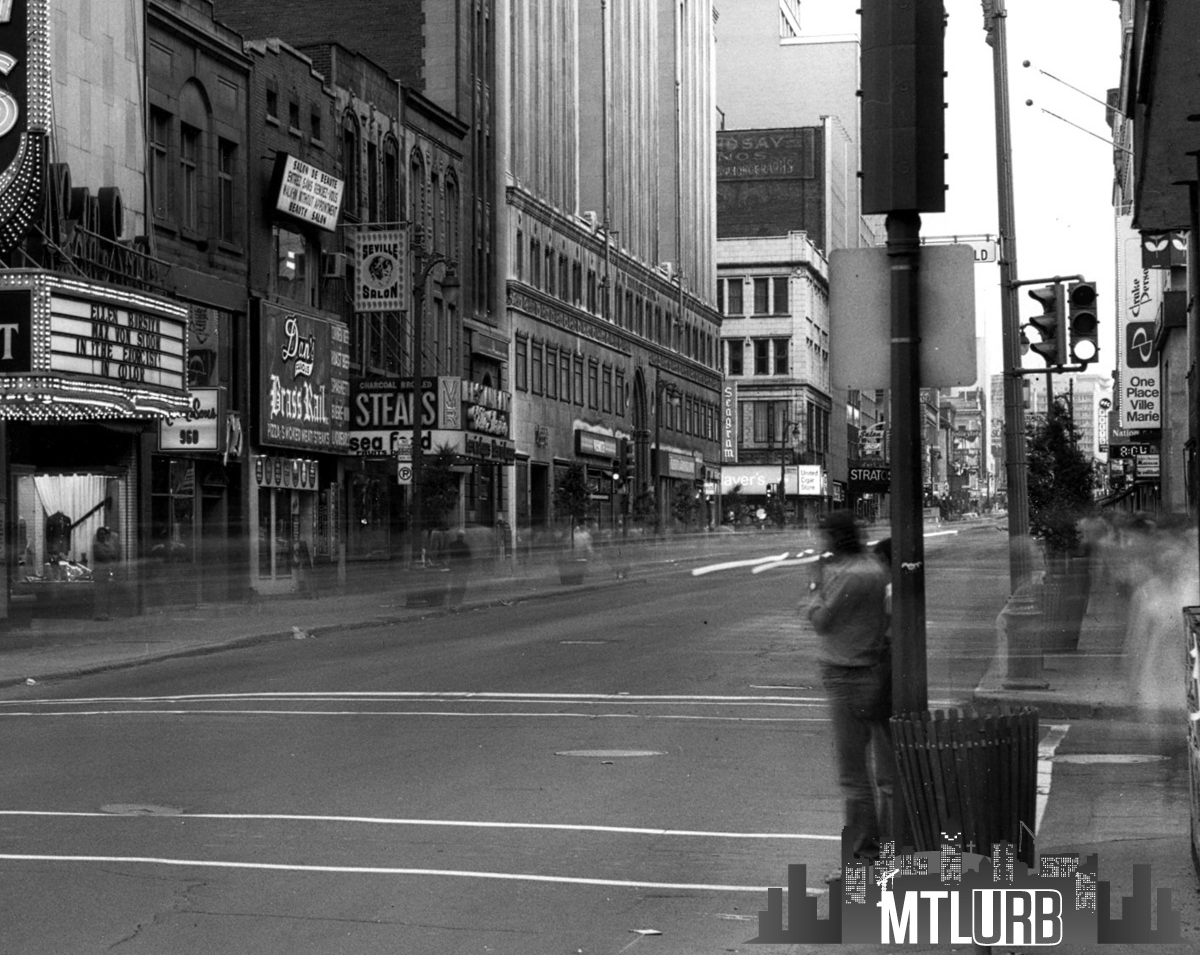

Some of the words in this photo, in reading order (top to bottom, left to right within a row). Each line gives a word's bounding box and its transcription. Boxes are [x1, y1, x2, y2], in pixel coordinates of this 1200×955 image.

[293, 160, 309, 175] SALON
[311, 169, 319, 180] DE
[288, 201, 308, 217] BEAUTY
[311, 211, 327, 225] SALON
[362, 244, 398, 261] SEVILLE
[362, 281, 398, 299] SALON
[91, 305, 117, 323] ELLEN
[91, 323, 108, 340] MAX
[116, 326, 131, 344] VON
[76, 338, 86, 355] IN
[101, 359, 109, 377] IN
[118, 364, 145, 382] COLOR
[359, 381, 397, 389] CHARCOAL
[1130, 376, 1155, 387] One
[270, 374, 302, 420] Brass
[303, 381, 326, 423] Rail
[1127, 387, 1159, 398] Place
[1130, 399, 1155, 410] Ville
[724, 387, 734, 458] Seagram
[1127, 410, 1159, 422] Marie
[349, 436, 383, 452] sea
[390, 430, 432, 451] fd
[800, 469, 819, 477] United
[800, 483, 816, 491] Store
